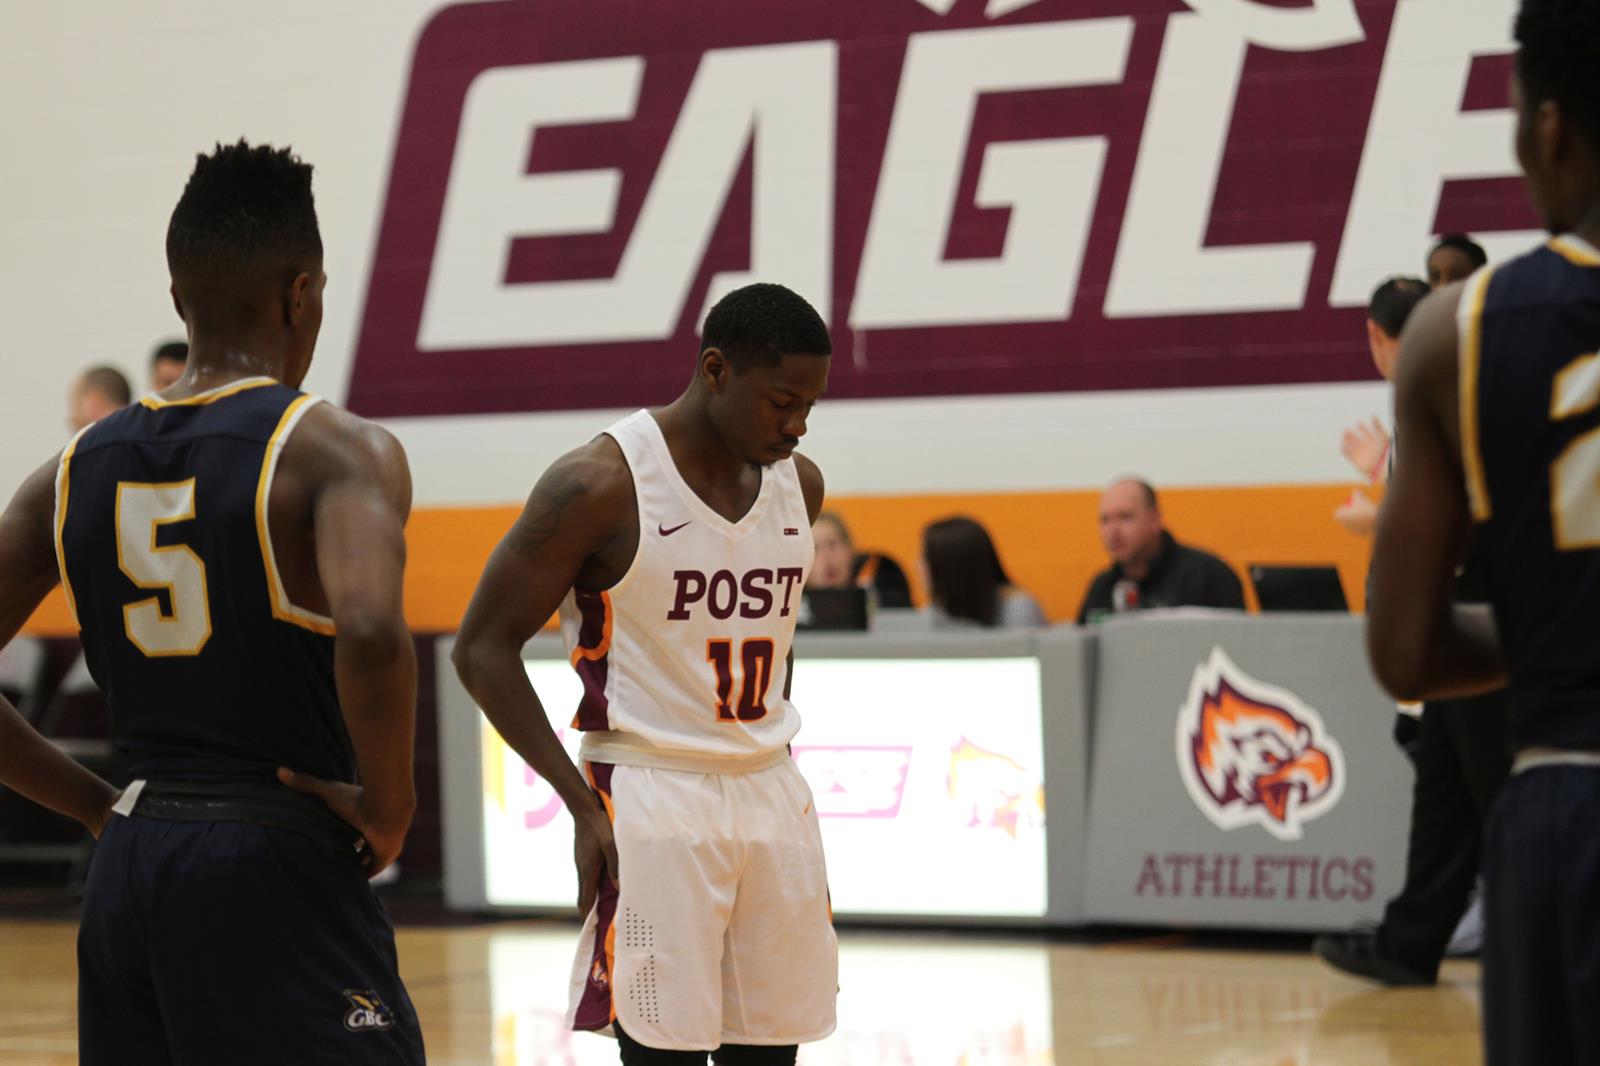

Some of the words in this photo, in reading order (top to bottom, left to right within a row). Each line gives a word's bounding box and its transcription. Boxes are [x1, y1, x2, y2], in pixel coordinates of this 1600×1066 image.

[115, 477, 212, 658] 5
[667, 567, 803, 621] POST
[706, 636, 775, 723] 10
[1134, 852, 1376, 902] ATHLETICS
